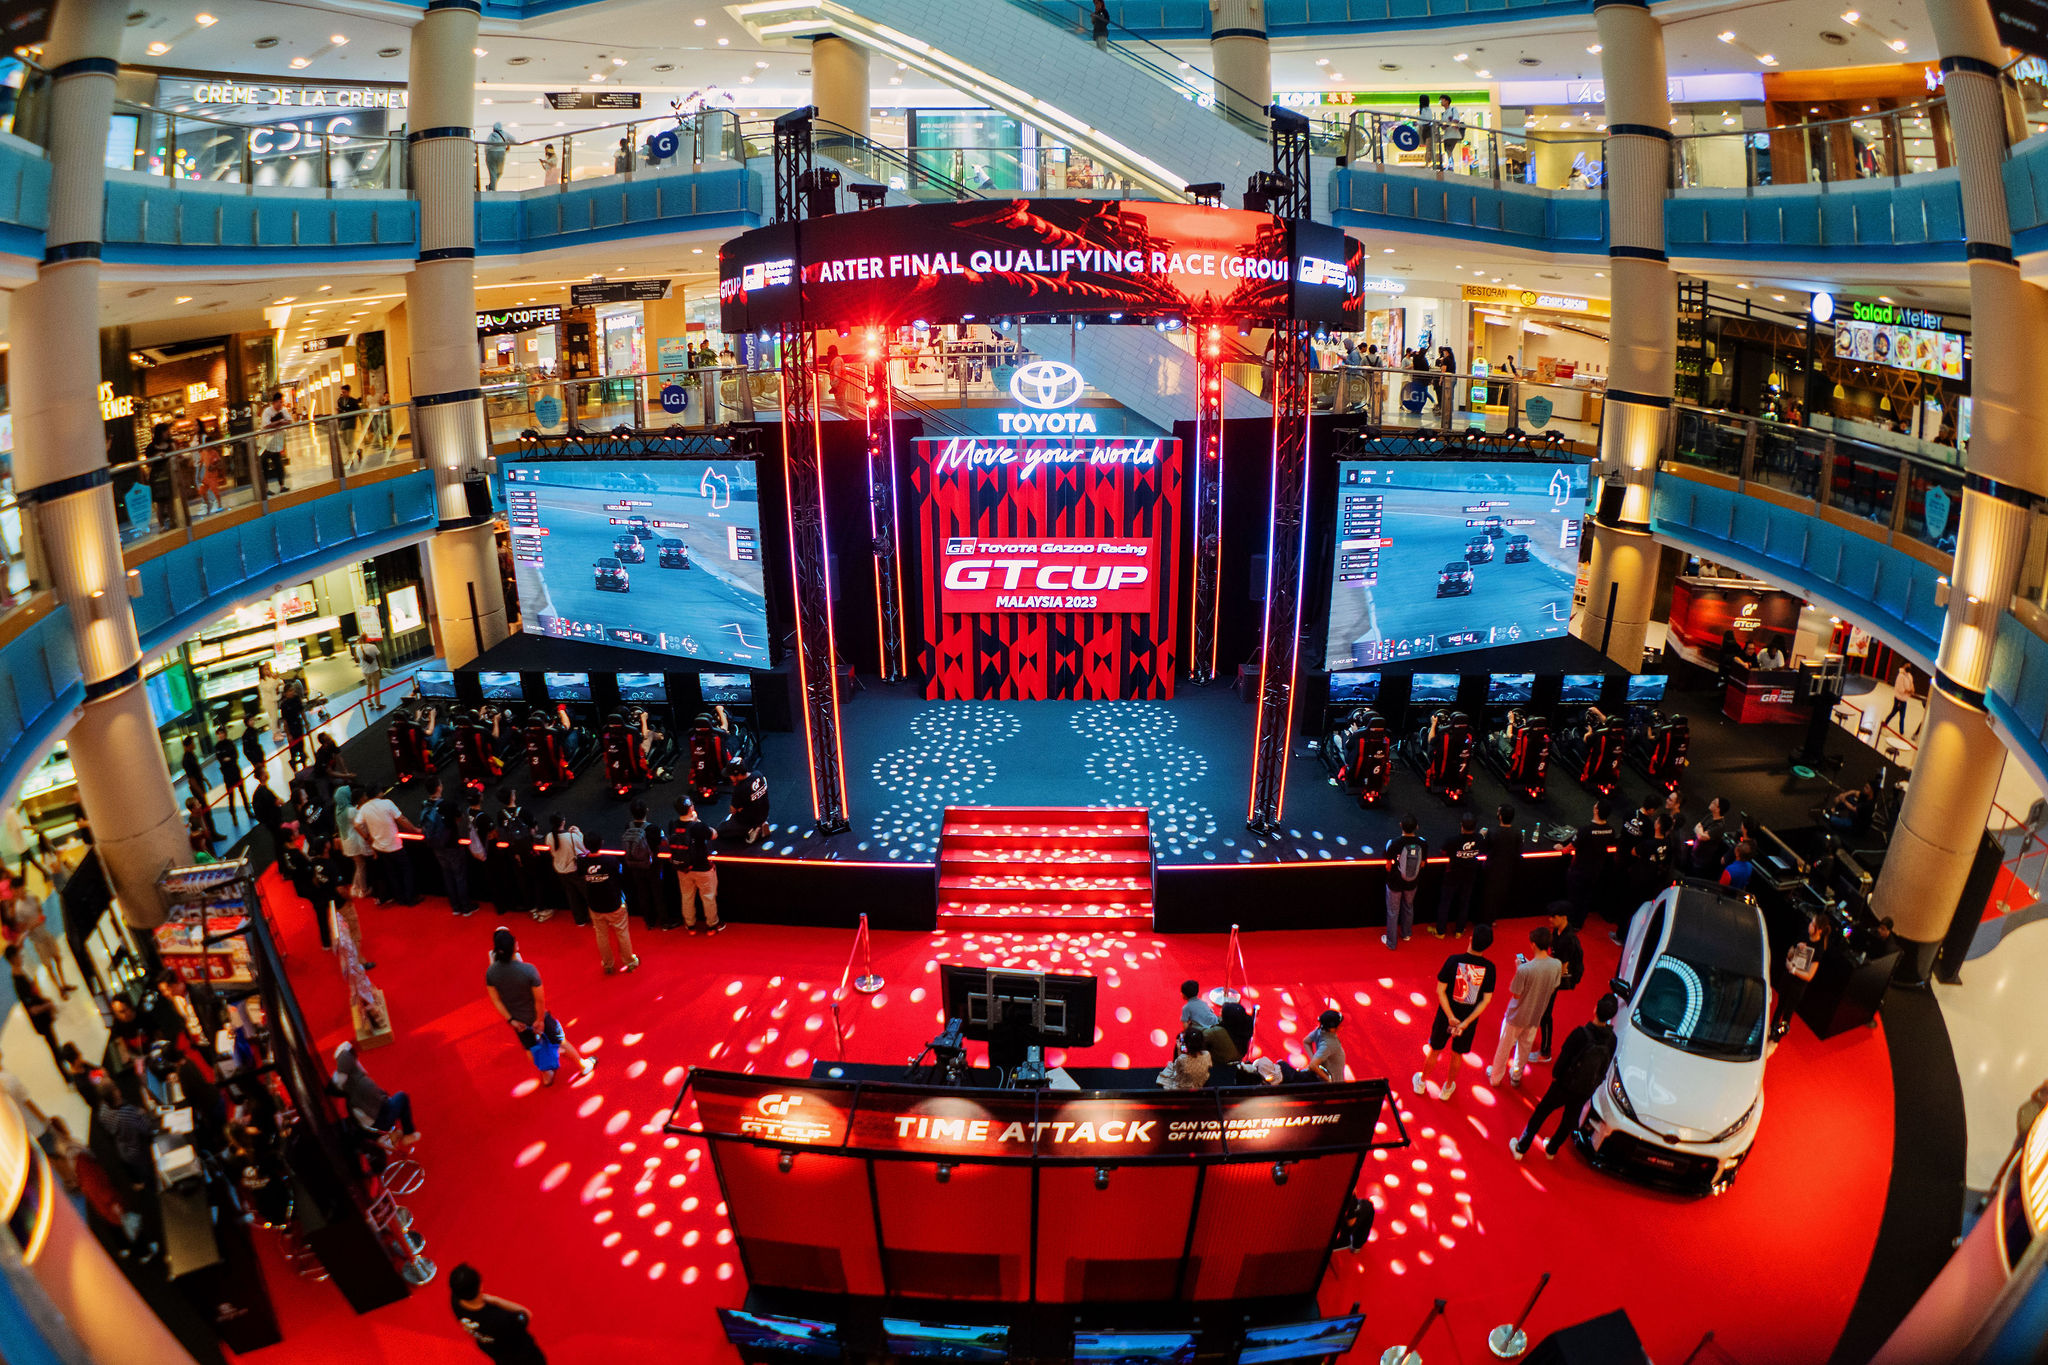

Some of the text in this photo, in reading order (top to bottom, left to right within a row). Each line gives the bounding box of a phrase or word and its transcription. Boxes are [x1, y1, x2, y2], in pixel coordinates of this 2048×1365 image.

[194, 80, 259, 104] CRÈME
[335, 87, 400, 108] CRÈME
[1279, 92, 1321, 106] KOPI
[659, 138, 671, 150] G
[1400, 132, 1413, 145] G
[889, 252, 964, 277] FINAL
[970, 250, 1144, 273] QUALIFYING
[1151, 252, 1215, 276] RACE
[1466, 285, 1507, 298] RESTORAN
[513, 307, 561, 323] COFFEE
[1853, 301, 1943, 330] Salad Atelier
[663, 393, 686, 405] LG1
[99, 395, 134, 421] ENGE
[998, 413, 1097, 433] TOYOTA
[936, 437, 1159, 480] Move your world
[947, 543, 1147, 556] GR TOYOTA GAZOO Racing
[1036, 566, 1148, 590] CUP
[996, 595, 1097, 608] MALAYSIA 2023
[1761, 694, 1778, 702] GR
[895, 1116, 1158, 1143] TIME ATTACK
[1169, 1121, 1199, 1131] CAN
[1228, 1118, 1262, 1130] BEAT
[1261, 1117, 1286, 1128] THE
[1285, 1115, 1312, 1127] LAP
[1311, 1113, 1341, 1126] TIME
[1168, 1131, 1186, 1141] OF
[1195, 1131, 1222, 1141] MIN
